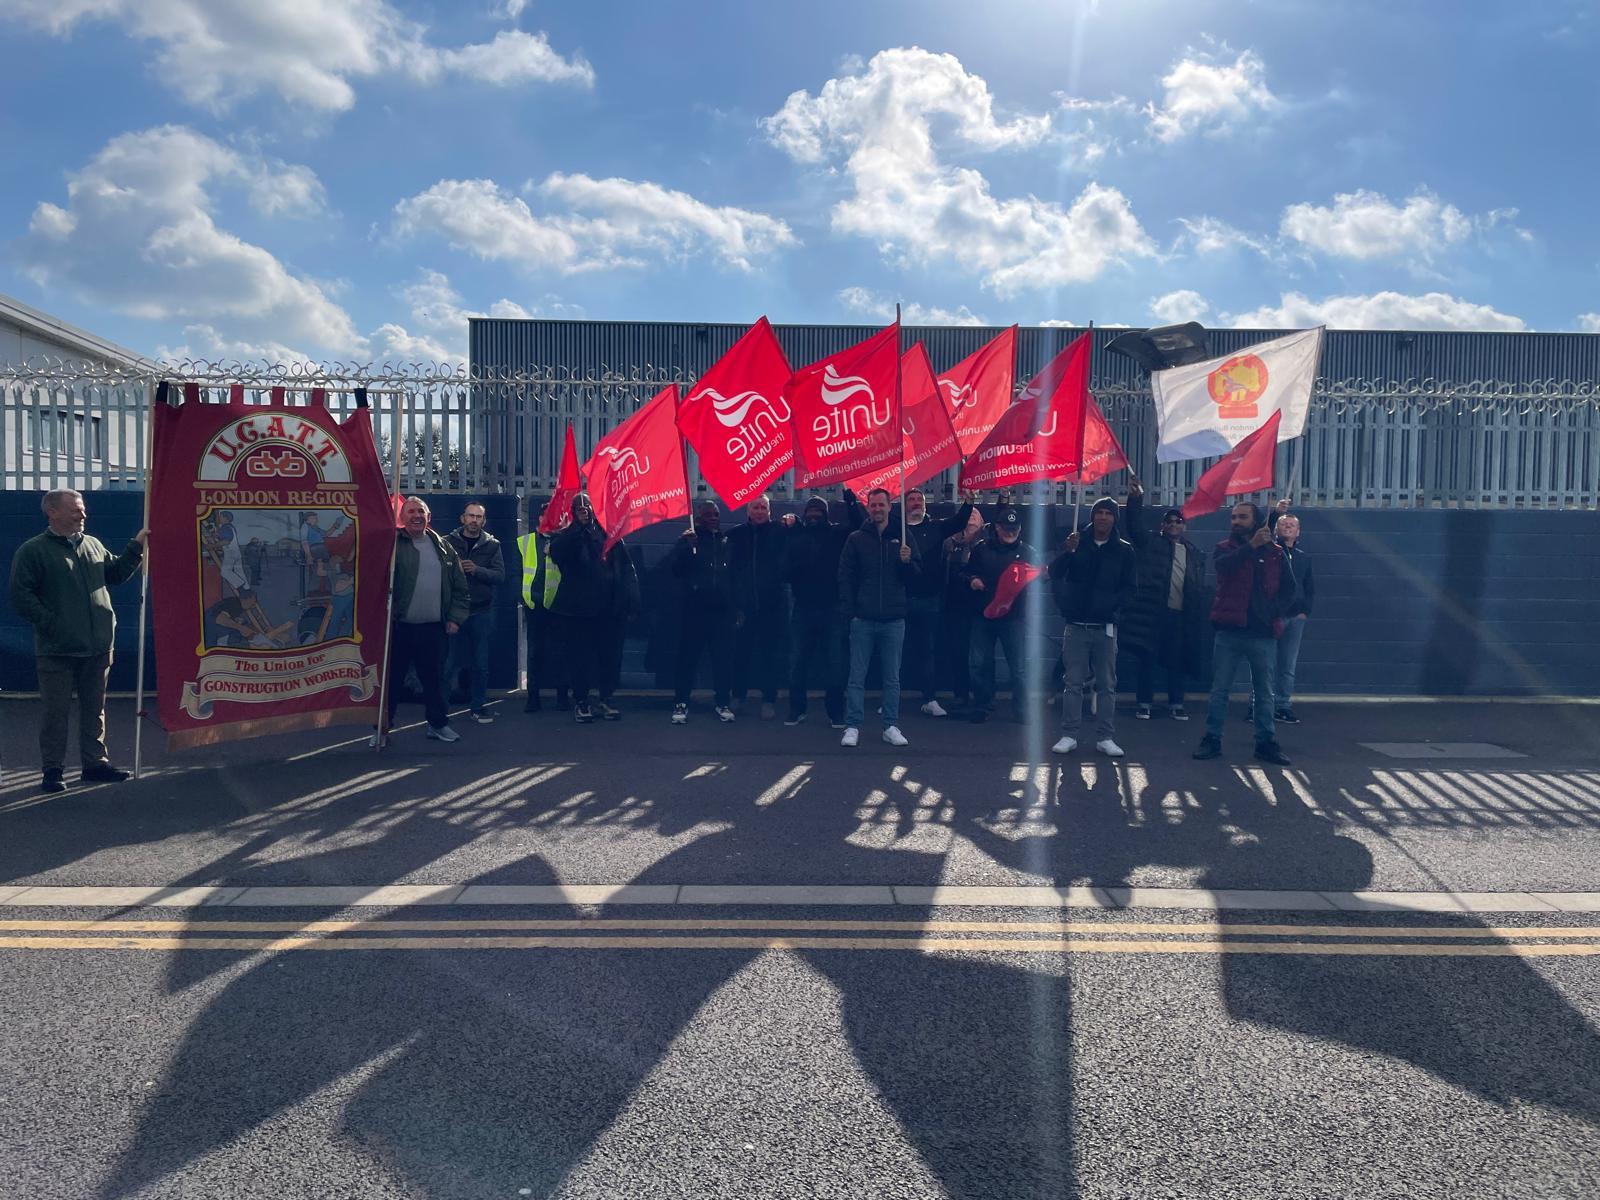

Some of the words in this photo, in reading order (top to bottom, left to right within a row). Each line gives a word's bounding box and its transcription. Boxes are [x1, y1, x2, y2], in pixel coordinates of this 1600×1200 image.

[200, 490, 281, 505] LONDON
[287, 490, 357, 505] REGION
[235, 659, 260, 672] The
[263, 660, 305, 672] Union
[307, 653, 326, 665] for
[204, 679, 301, 694] CONSTRUCTION
[303, 667, 362, 686] WORKERS
